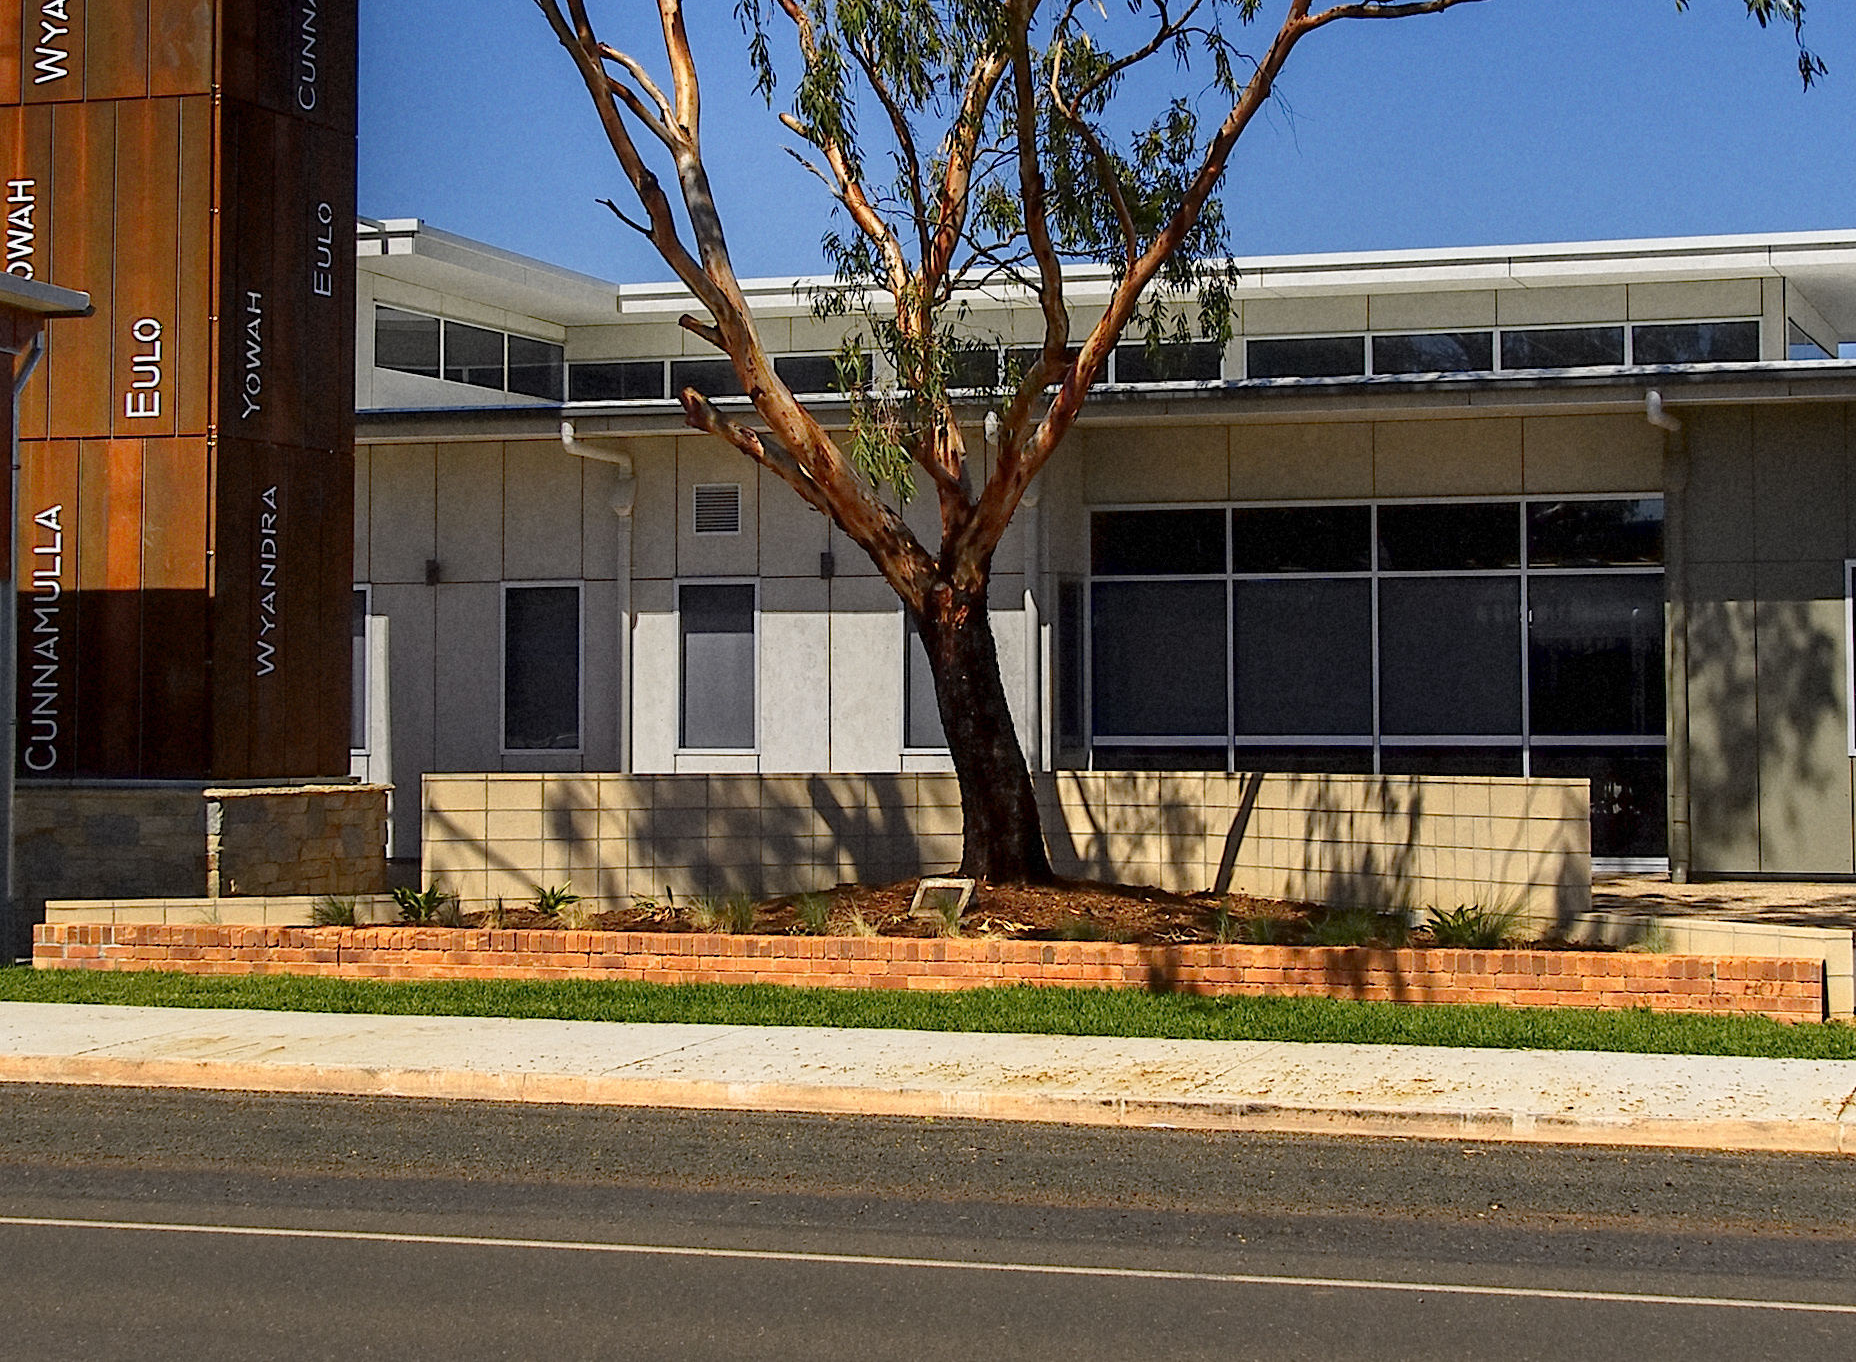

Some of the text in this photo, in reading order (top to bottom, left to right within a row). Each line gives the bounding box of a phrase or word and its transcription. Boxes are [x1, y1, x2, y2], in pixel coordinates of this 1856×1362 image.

[5, 179, 36, 281] OWAH
[314, 202, 332, 297] EULO
[125, 317, 162, 419] EULO
[242, 291, 263, 419] YOWAH
[24, 504, 62, 771] CUNNAMULLA
[256, 486, 277, 677] WYANDRA
